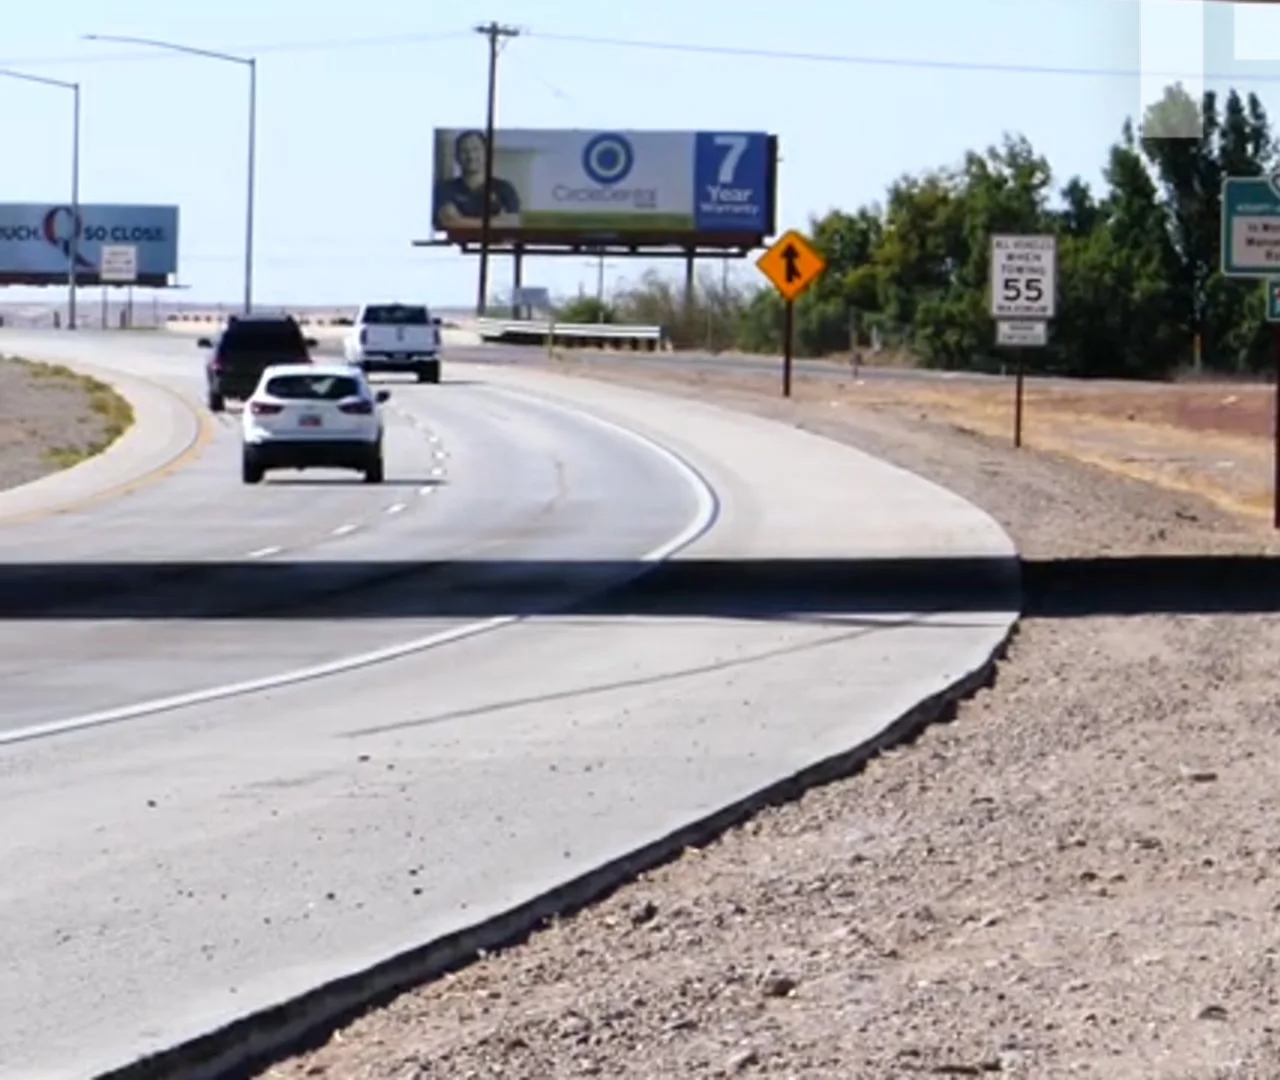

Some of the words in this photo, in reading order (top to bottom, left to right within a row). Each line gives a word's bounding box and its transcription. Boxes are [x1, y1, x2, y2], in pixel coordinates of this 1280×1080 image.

[713, 135, 748, 183] 7
[706, 185, 754, 202] Year
[84, 225, 108, 241] SO
[1003, 278, 1044, 302] 55
